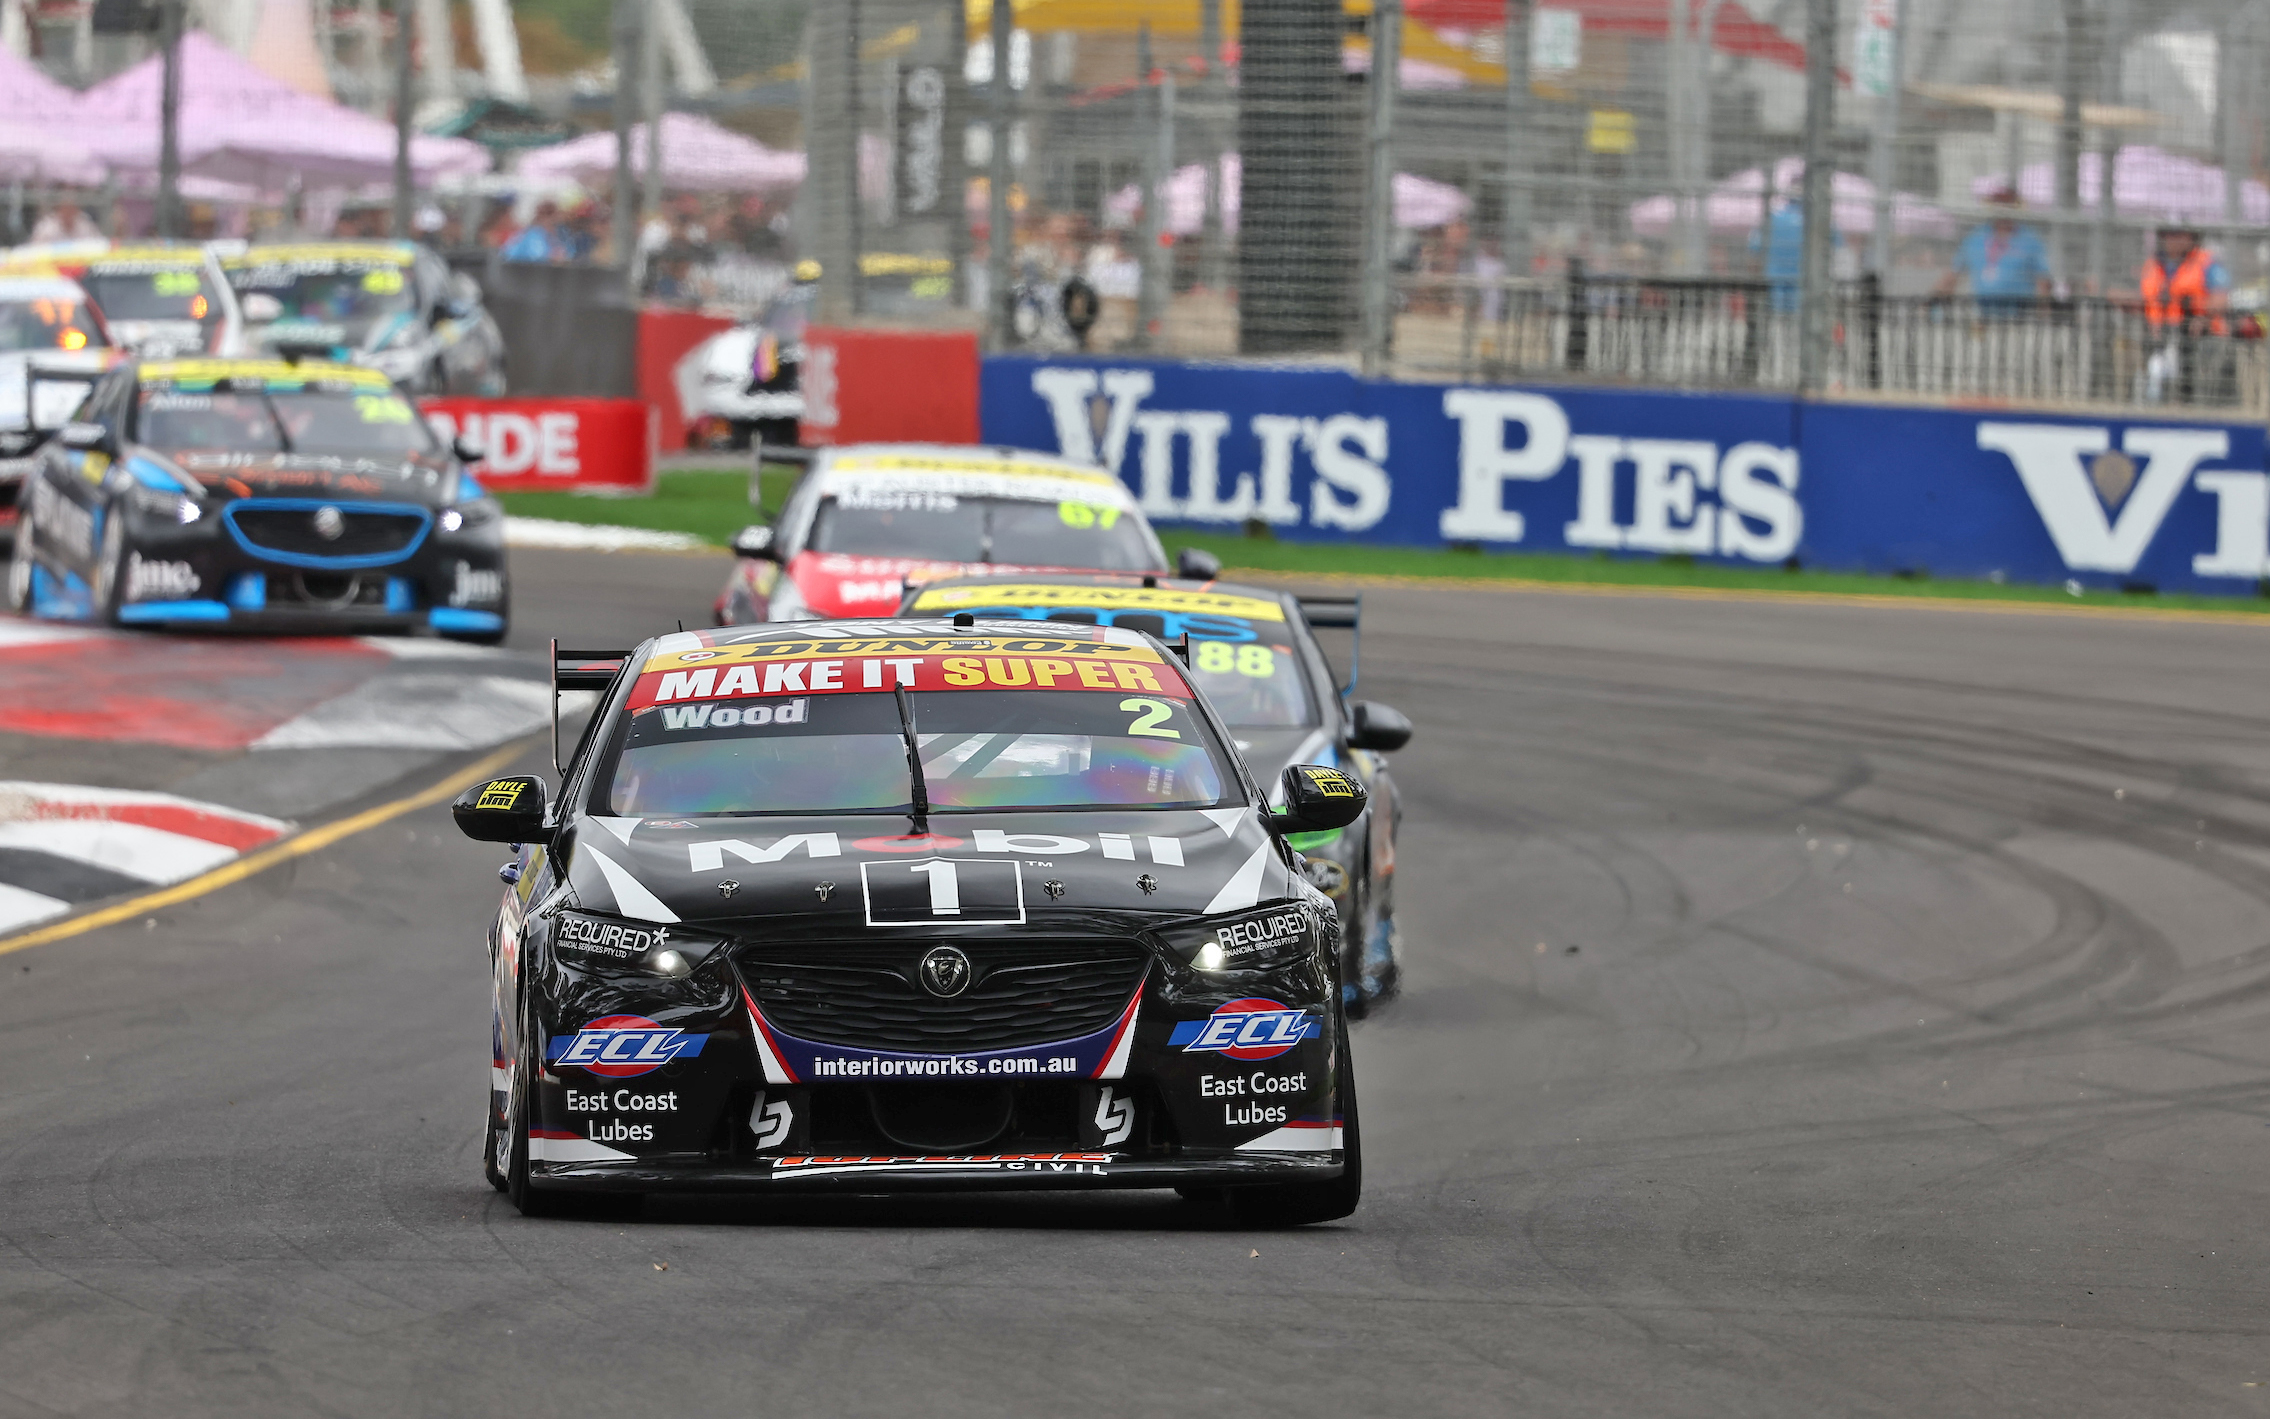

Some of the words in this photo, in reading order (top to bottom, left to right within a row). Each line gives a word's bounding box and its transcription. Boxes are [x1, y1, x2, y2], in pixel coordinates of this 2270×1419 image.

[1438, 388, 1803, 563] PIES
[1058, 499, 1122, 530] 67
[741, 637, 1131, 658] DUNLOP
[1197, 640, 1275, 678] 88
[655, 660, 844, 702] MAKE
[862, 657, 925, 690] IT
[943, 658, 1164, 692] SUPER
[663, 698, 806, 731] Wood
[1119, 697, 1181, 739] 2
[486, 781, 528, 792] DAYLE
[688, 829, 1185, 872] Mobil
[909, 859, 962, 916] 1
[556, 939, 578, 950] FINANCIAL
[578, 942, 603, 954] SERVICES
[603, 946, 616, 956] PTY
[615, 949, 627, 959] LTD
[1222, 943, 1255, 958] FINANCIAL
[1255, 938, 1281, 951] SERVICES
[1281, 936, 1291, 946] PTY
[1194, 1011, 1311, 1049] ECL
[558, 1029, 689, 1063] ECL
[814, 1055, 1077, 1076] interiorworks.com.au
[1200, 1073, 1246, 1097] East
[1250, 1071, 1307, 1095] Coast
[566, 1089, 609, 1112] East
[613, 1088, 678, 1111] Coast
[1225, 1101, 1287, 1125] Lubes
[588, 1118, 654, 1141] Lubes
[1006, 1161, 1108, 1176] CIVIL
